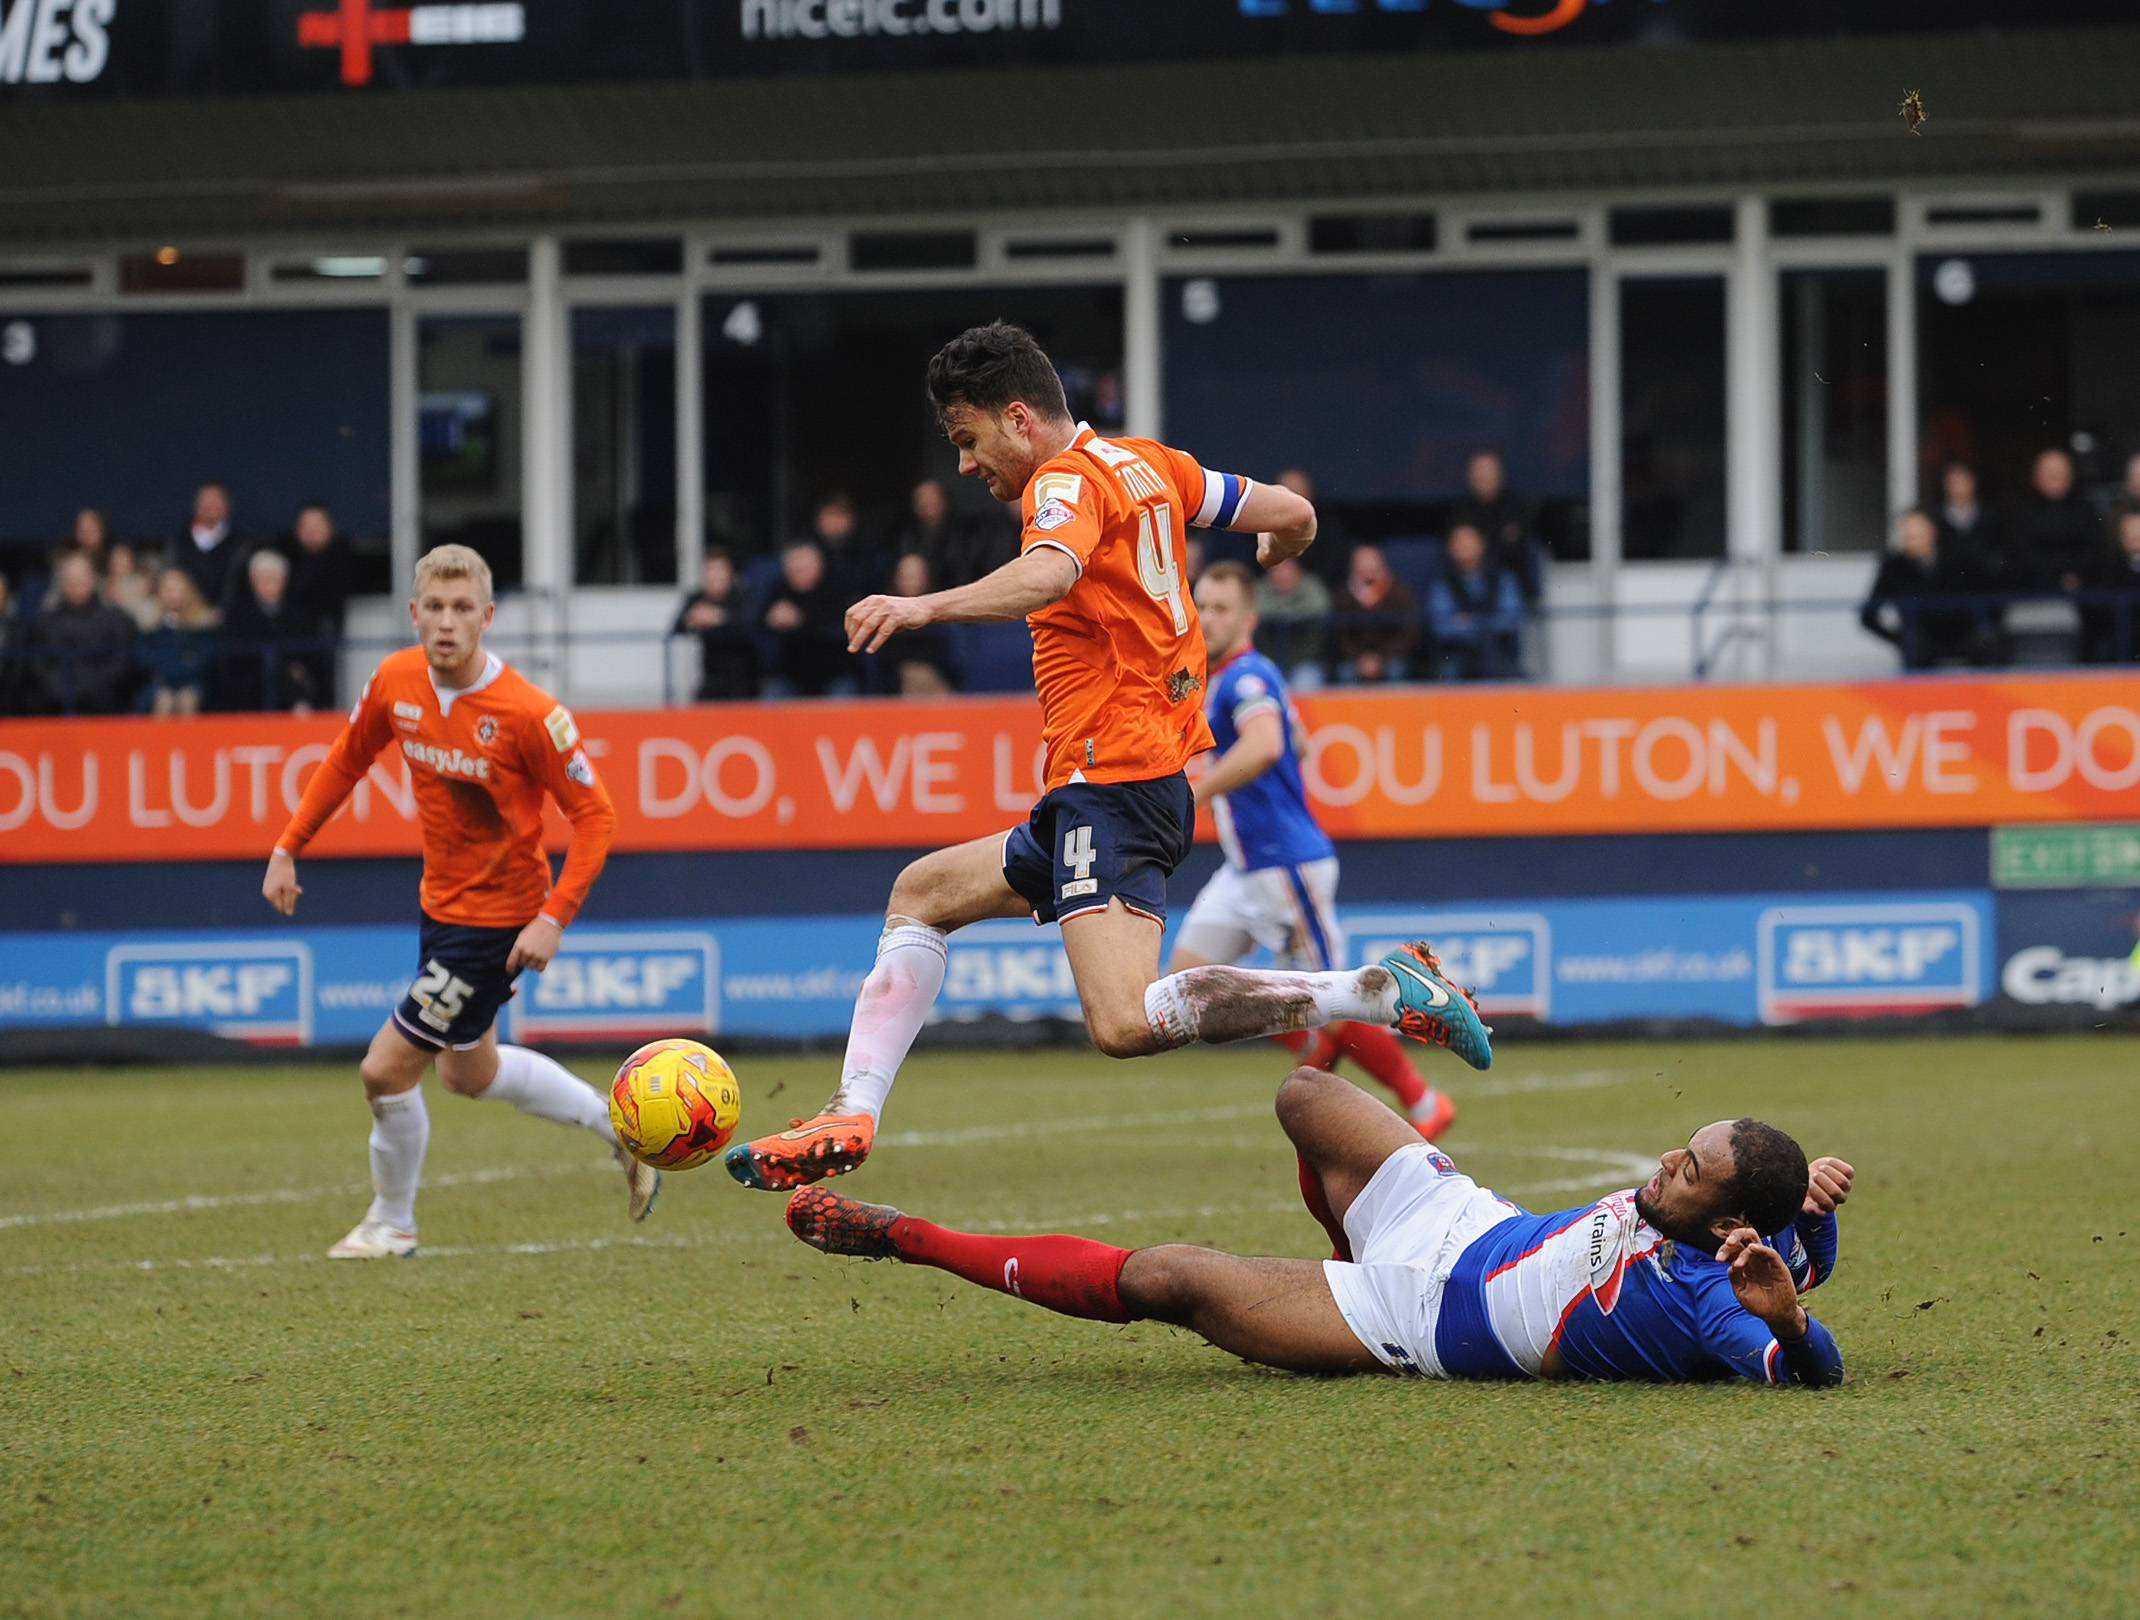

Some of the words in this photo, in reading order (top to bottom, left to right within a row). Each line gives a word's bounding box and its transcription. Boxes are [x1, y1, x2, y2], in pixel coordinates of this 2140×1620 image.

[1136, 502, 1188, 636] 4
[402, 738, 491, 780] easyJet
[637, 735, 797, 826] DO,
[814, 731, 970, 814] WE
[1301, 722, 1443, 808] OU
[1470, 715, 1800, 808] LUTON,
[1820, 709, 1982, 796] WE
[2006, 704, 2140, 792] DO
[1063, 826, 1097, 880] 4
[1063, 882, 1092, 898] FILA
[131, 964, 293, 1018] SKF
[534, 955, 698, 1009] SKF
[1783, 928, 1957, 983] SKF
[409, 957, 475, 1021] 25
[1590, 1212, 1608, 1268] trains
